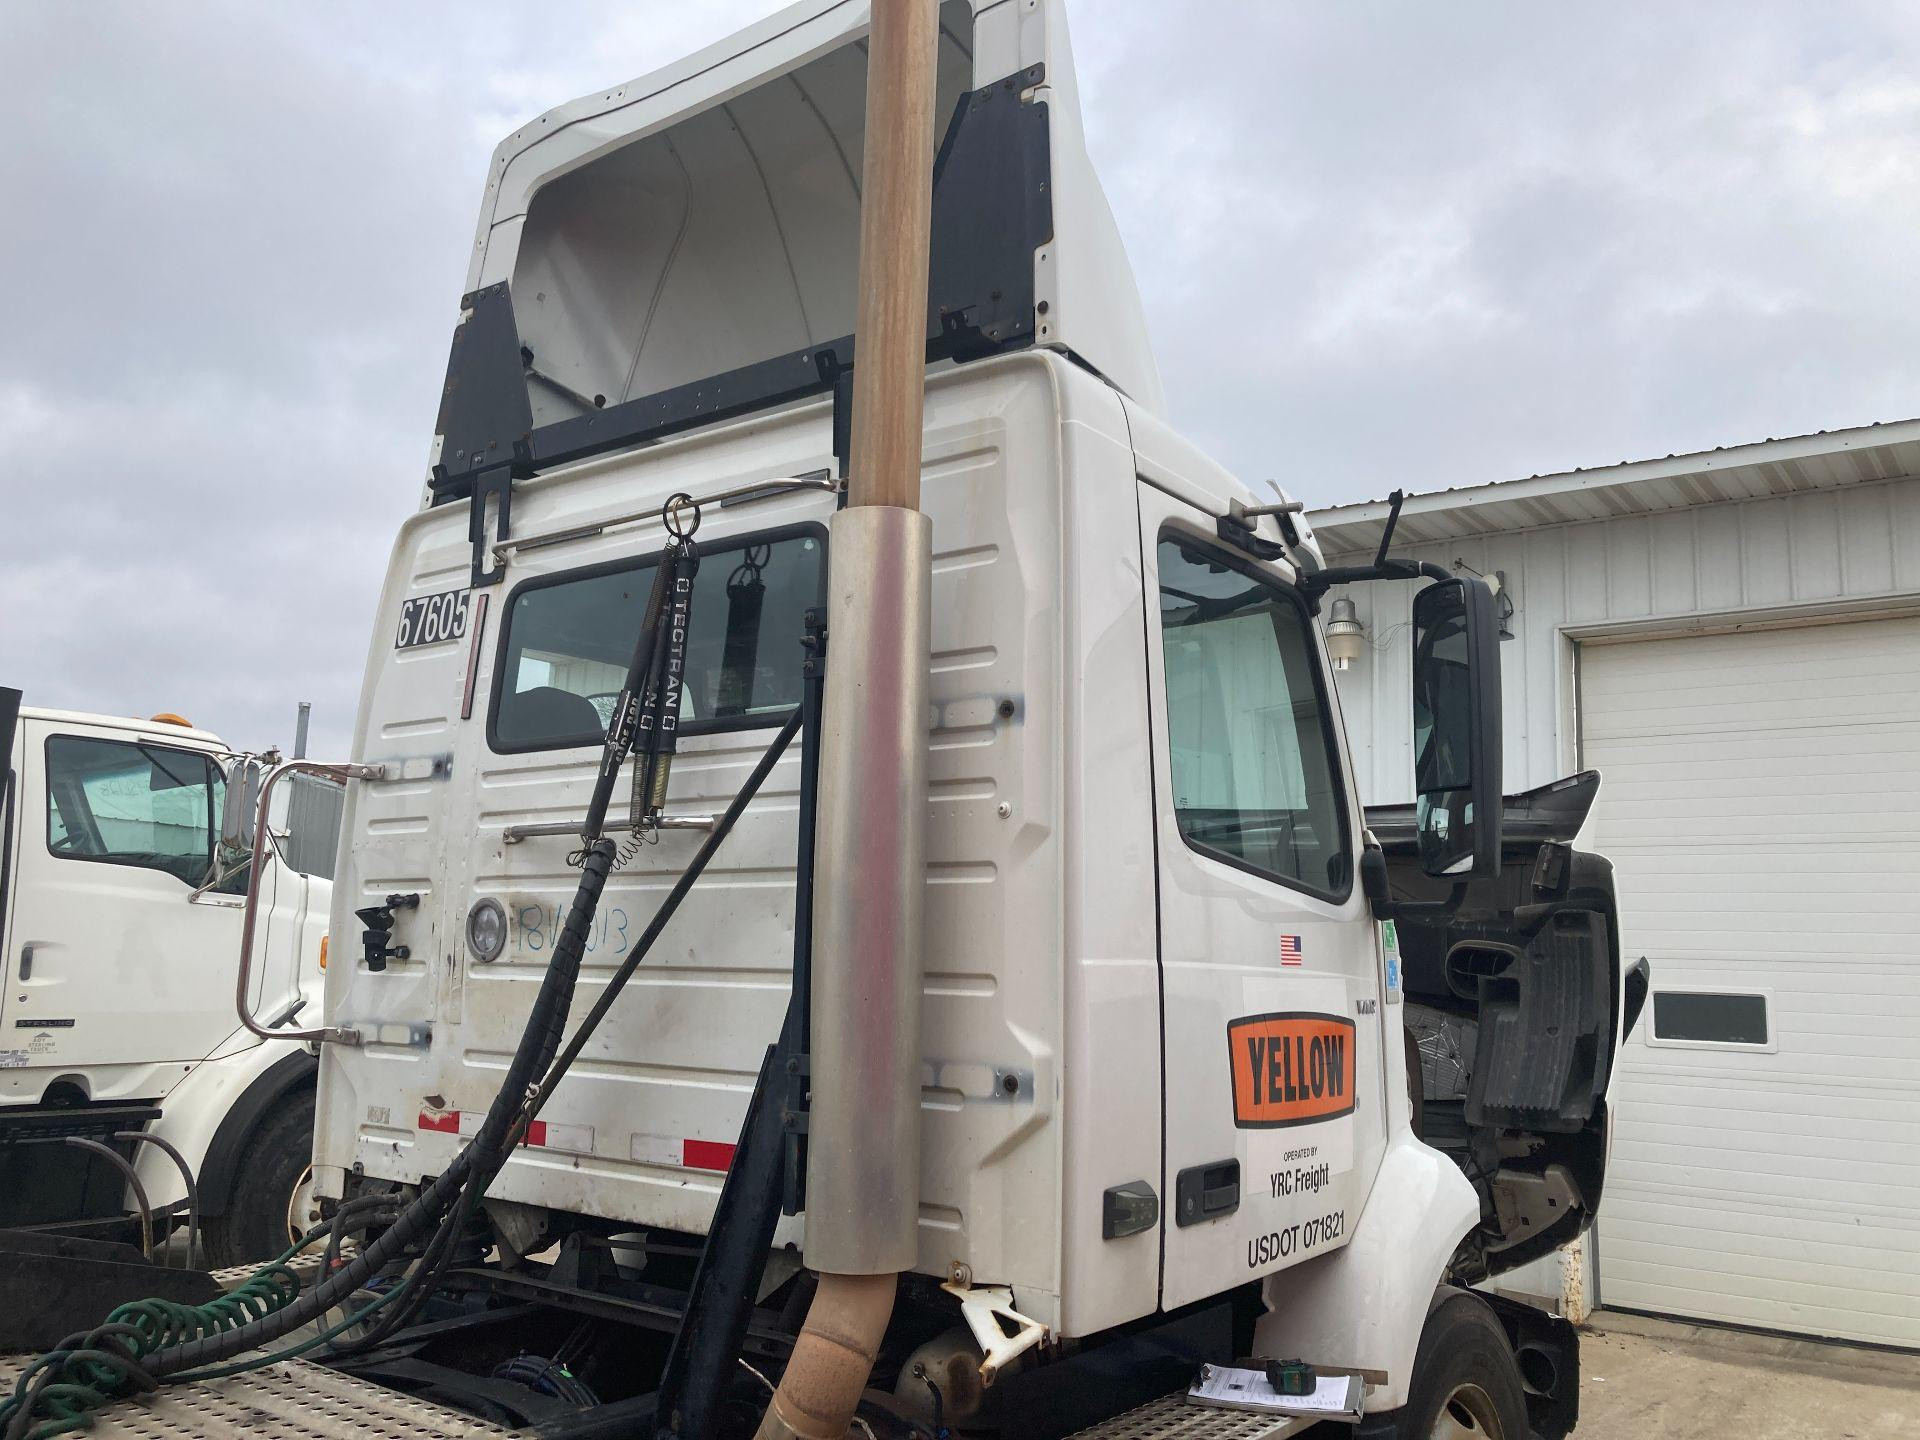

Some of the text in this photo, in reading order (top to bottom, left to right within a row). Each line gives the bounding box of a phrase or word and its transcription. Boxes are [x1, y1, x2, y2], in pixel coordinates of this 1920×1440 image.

[398, 589, 470, 647] 67605
[665, 600, 687, 709] TECTRAN
[1248, 1035, 1344, 1105] YELLOW
[1270, 1163, 1329, 1198] YRC Freight
[1283, 1146, 1318, 1162] OPERATED BY
[1248, 1210, 1344, 1269] USDOT 071821
